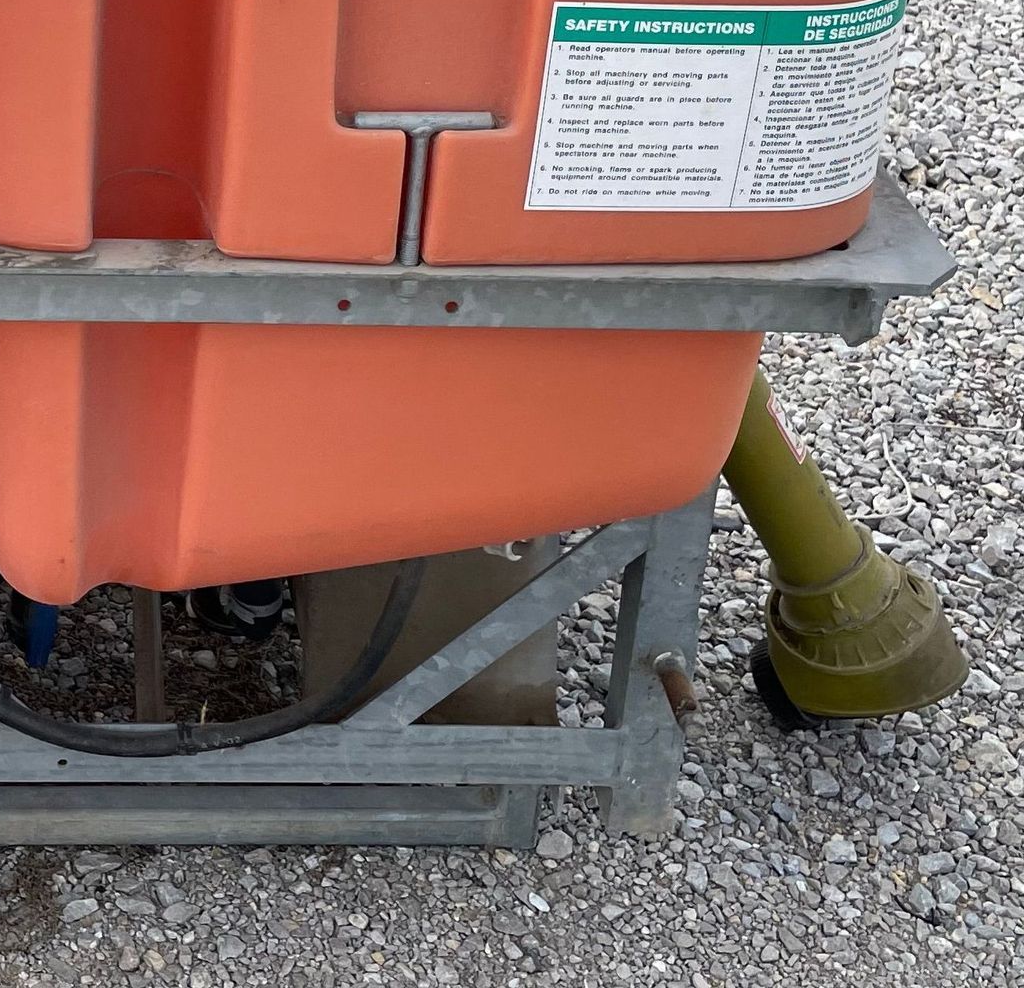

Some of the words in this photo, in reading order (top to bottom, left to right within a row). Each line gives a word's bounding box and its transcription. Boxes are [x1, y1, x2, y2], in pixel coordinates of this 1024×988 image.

[565, 19, 629, 31] SAFETY
[634, 20, 755, 34] INSTRUCTIONS
[829, 15, 892, 39] SEGURIDAD
[809, 46, 836, 54] manual
[605, 71, 647, 79] machinery
[673, 72, 703, 80] moving
[596, 79, 634, 87] adjusting
[653, 80, 692, 88] servicing.
[616, 95, 644, 103] guards
[679, 96, 701, 104] place
[559, 118, 589, 127] Inspect
[614, 120, 643, 128] replace
[795, 122, 828, 130] desgaste
[556, 142, 575, 150] Stop
[807, 137, 835, 146] maquina
[551, 174, 593, 182] equipment
